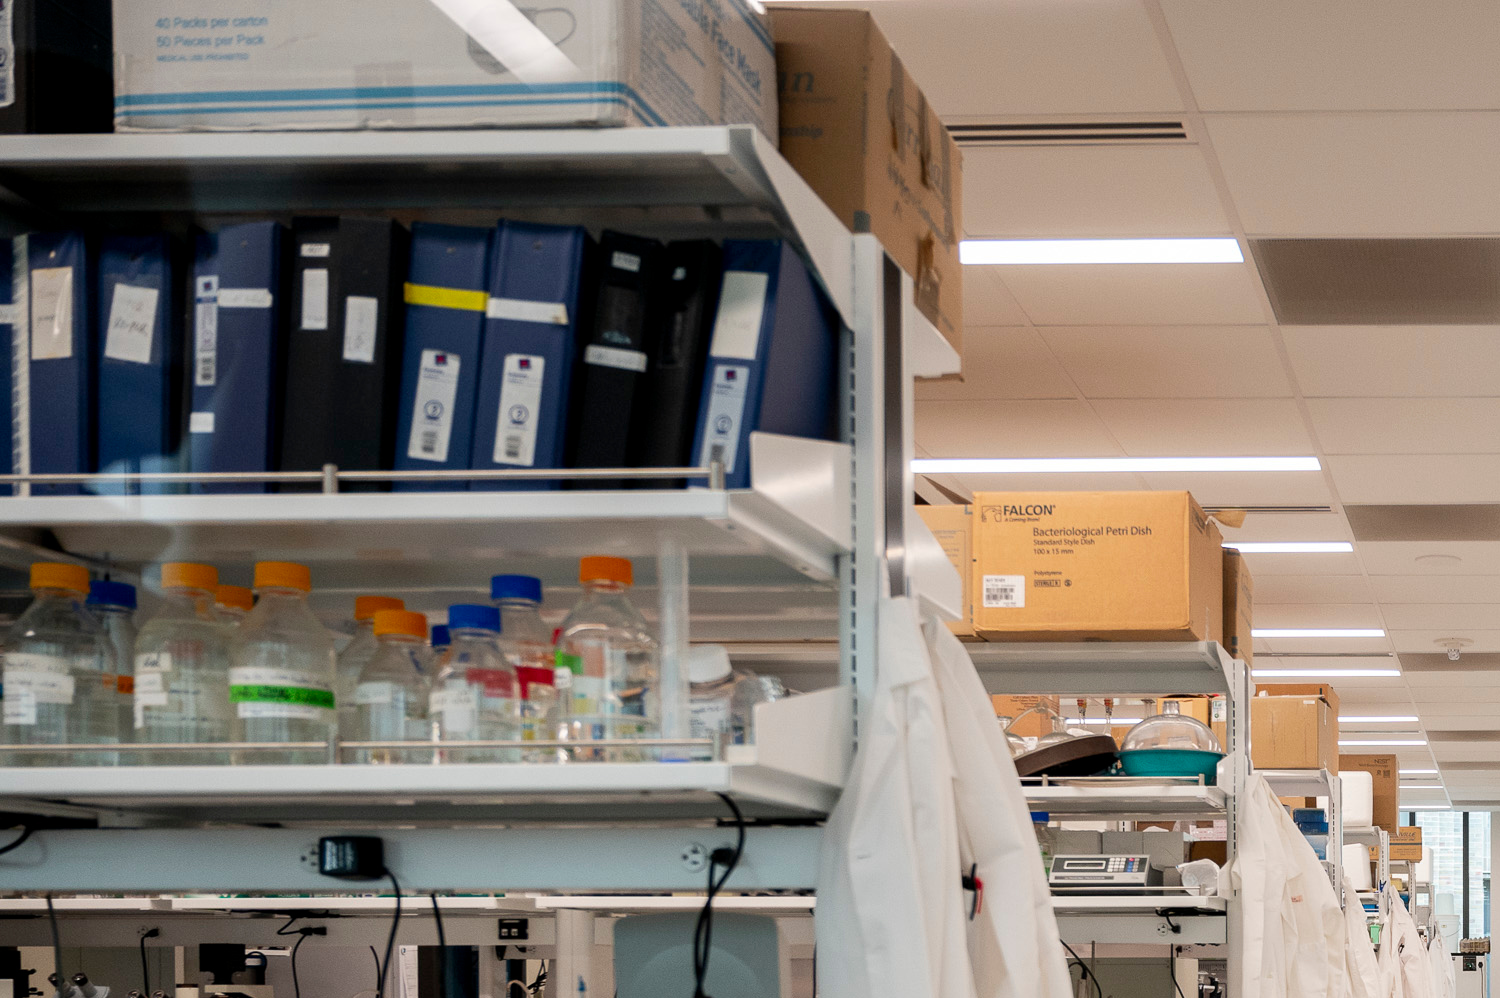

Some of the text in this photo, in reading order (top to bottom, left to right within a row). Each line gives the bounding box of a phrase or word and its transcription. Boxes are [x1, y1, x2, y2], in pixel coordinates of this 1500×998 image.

[155, 16, 269, 29] 40 Packs per carton
[156, 33, 264, 47] 50 Pieces per Pack
[1033, 526, 1152, 539] Bacteriological Petri Dish
